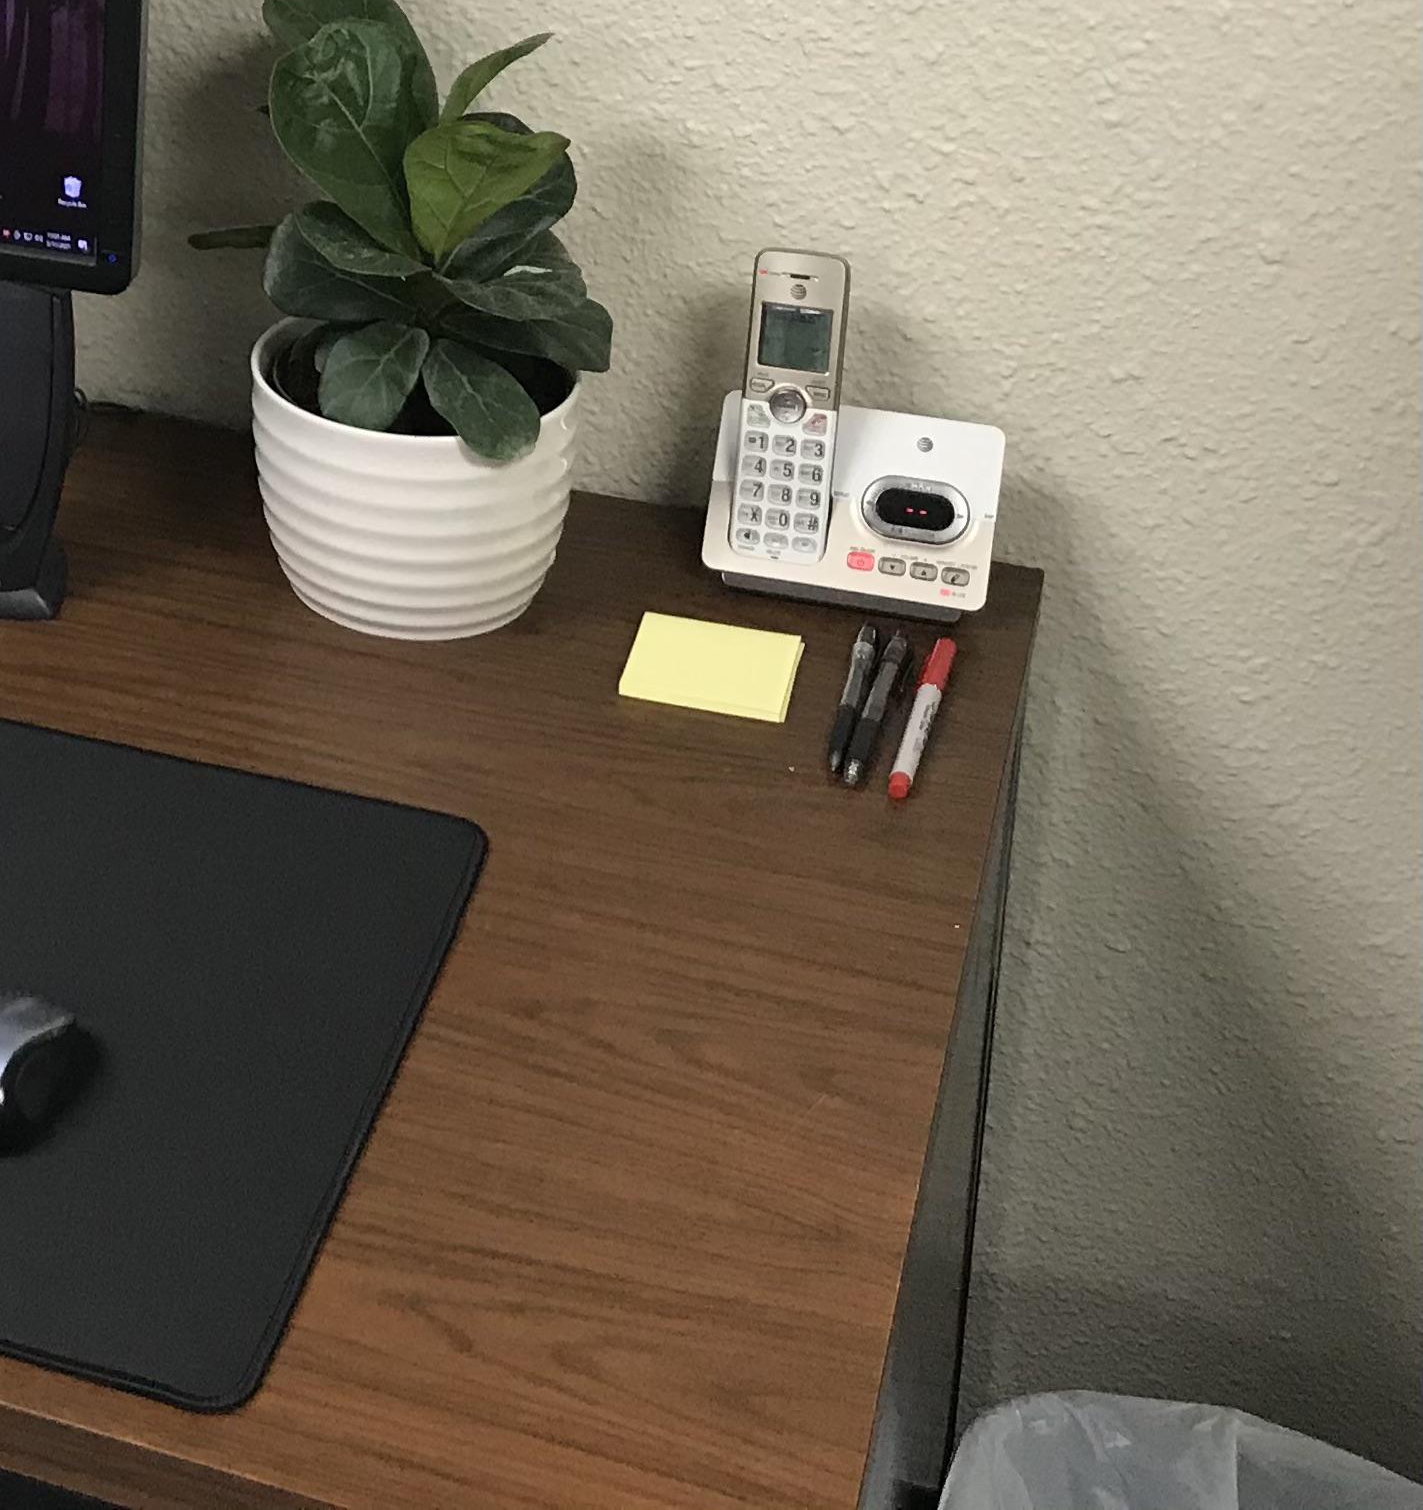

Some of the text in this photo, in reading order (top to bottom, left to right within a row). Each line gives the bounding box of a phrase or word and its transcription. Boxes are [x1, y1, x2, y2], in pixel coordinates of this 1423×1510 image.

[758, 436, 764, 449] 1
[785, 438, 796, 453] 2
[814, 443, 823, 457] 3
[754, 459, 763, 473] 4
[783, 462, 793, 477] 5
[812, 467, 821, 482] 6
[753, 482, 762, 497] 7
[781, 488, 790, 502] 8
[810, 492, 819, 506] 9
[779, 513, 788, 527] 0
